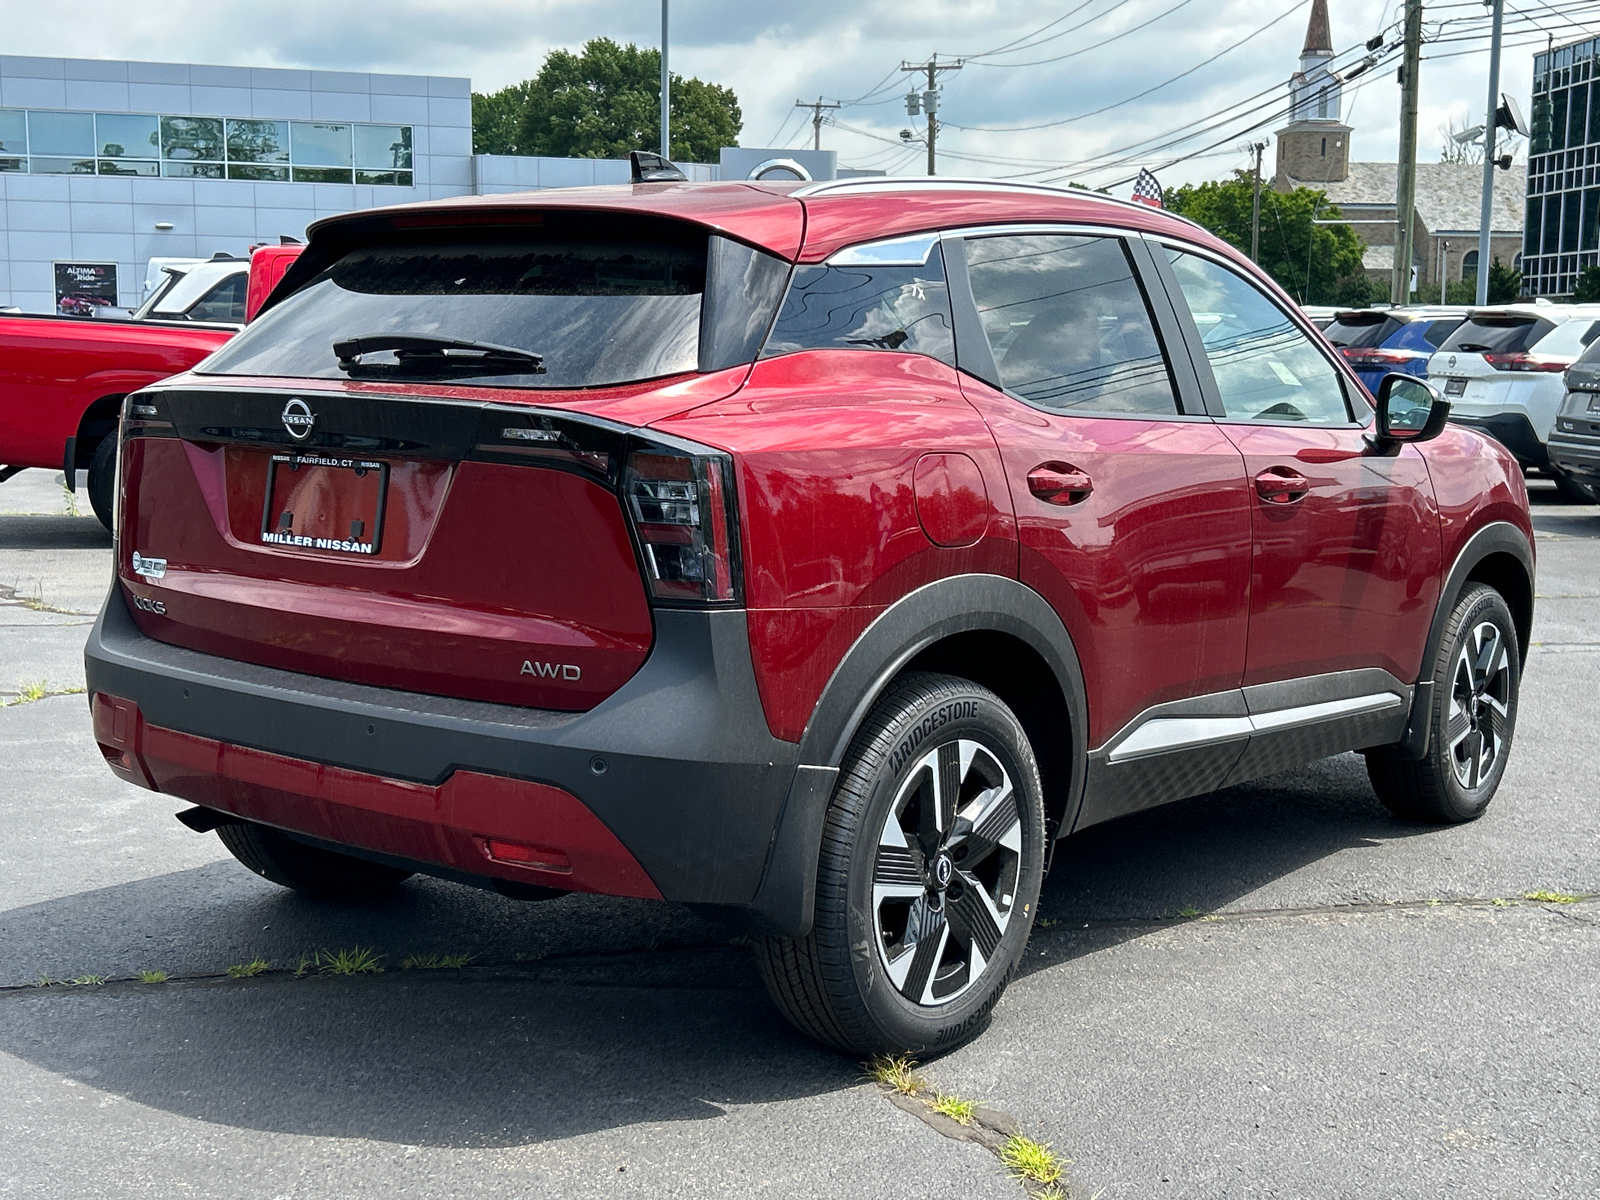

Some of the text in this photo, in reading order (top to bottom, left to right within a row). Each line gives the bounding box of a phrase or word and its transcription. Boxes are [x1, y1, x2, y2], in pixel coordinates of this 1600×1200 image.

[66, 265, 105, 275] ALTIMA
[282, 415, 314, 425] NISSAN
[297, 457, 340, 467] FAIRFIELD,
[262, 532, 372, 553] MILLER NISSAN
[520, 660, 581, 681] AWD
[889, 701, 978, 778] BRIDGESTONE
